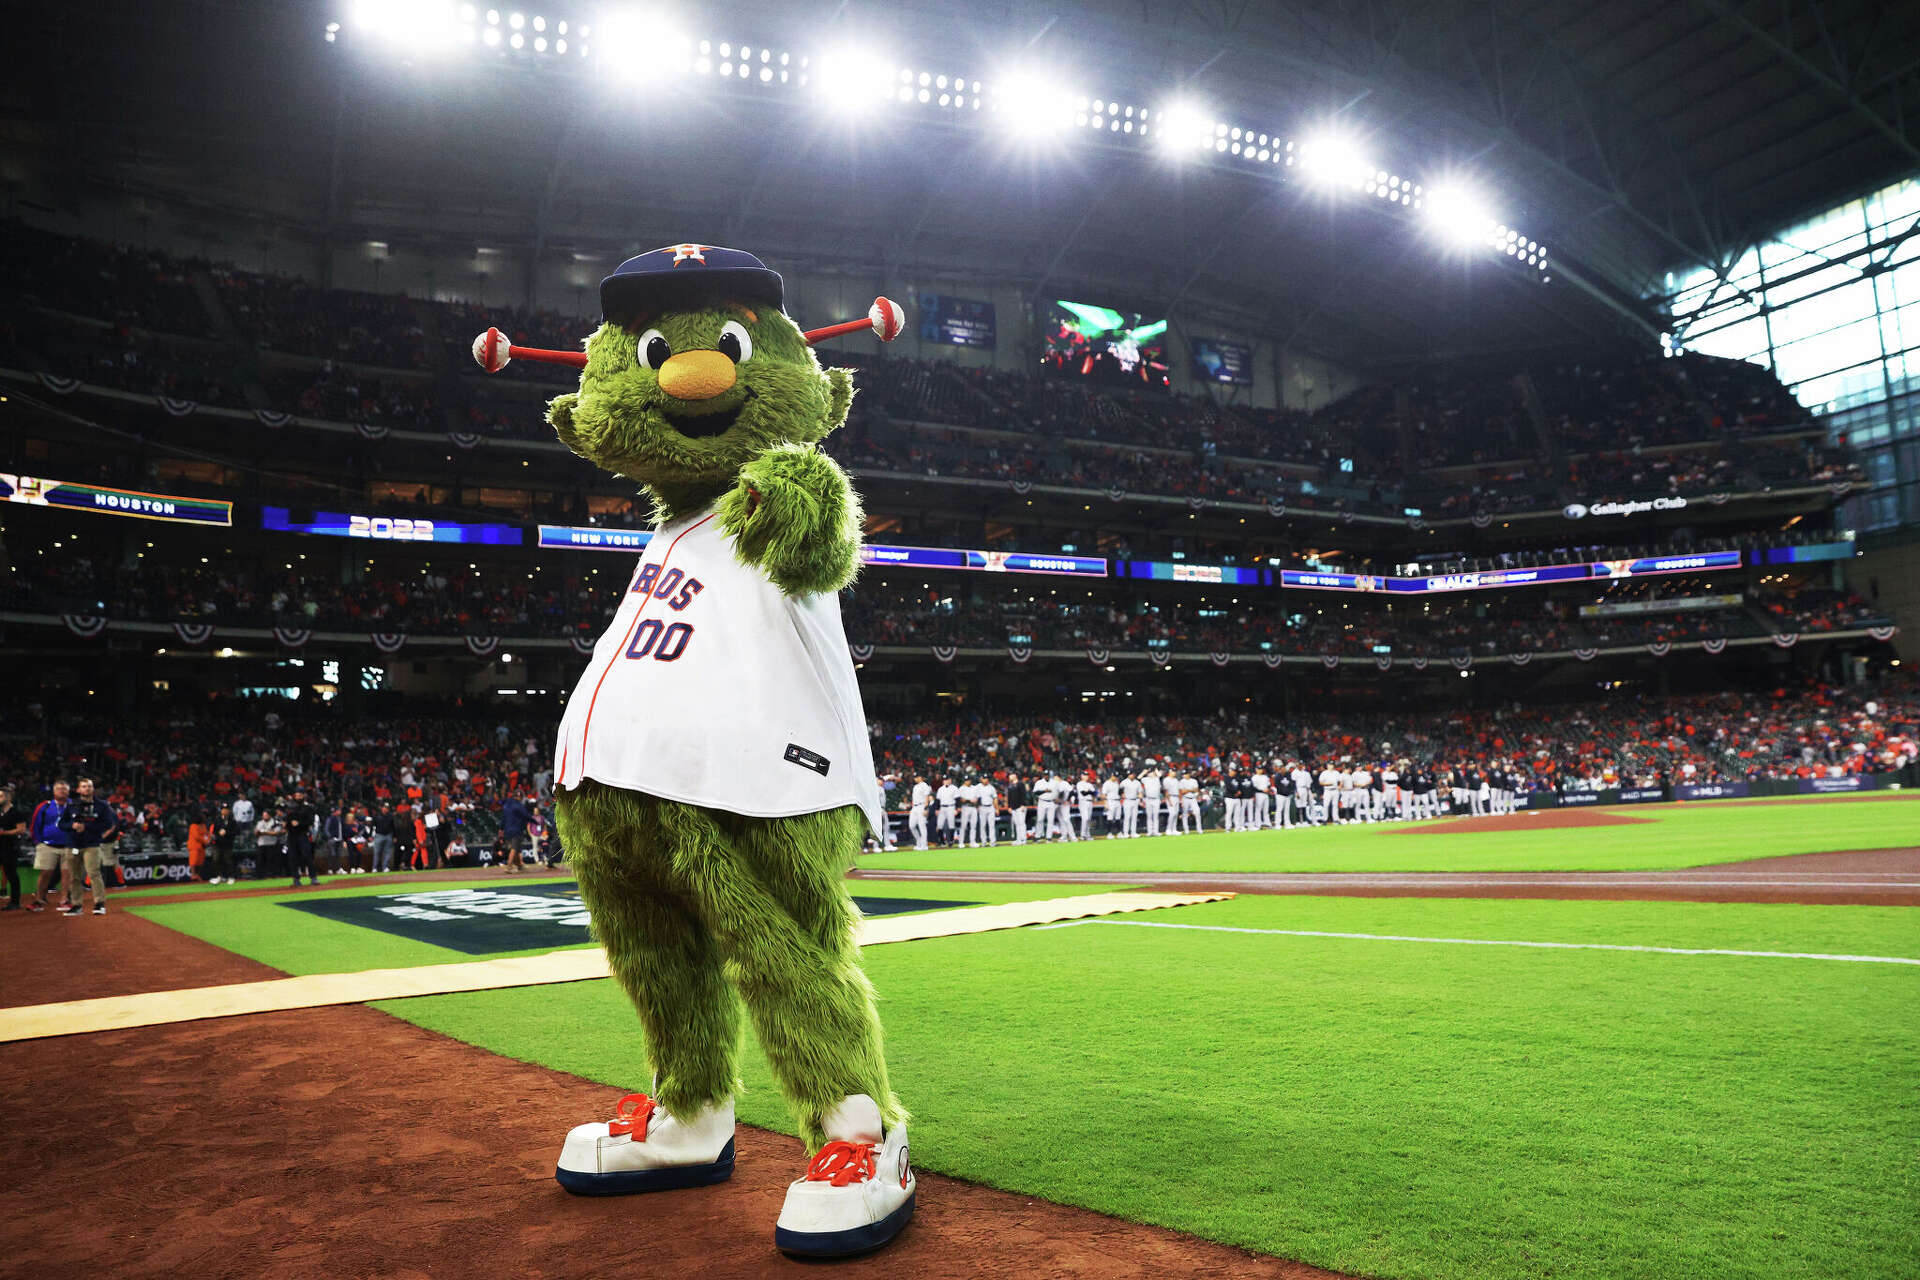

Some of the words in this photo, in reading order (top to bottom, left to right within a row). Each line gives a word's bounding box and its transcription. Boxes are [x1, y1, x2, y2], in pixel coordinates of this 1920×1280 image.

[95, 493, 175, 514] HOUSTON
[1590, 500, 1651, 516] Gallagher
[1653, 496, 1687, 510] Club
[349, 515, 434, 541] 2022
[571, 533, 601, 544] NEW
[606, 535, 639, 546] YORK
[1029, 559, 1076, 570] HOUSTON
[1655, 558, 1706, 570] HOUSTON
[631, 563, 705, 612] ROS
[625, 618, 696, 662] 00
[122, 864, 193, 881] oanDepo
